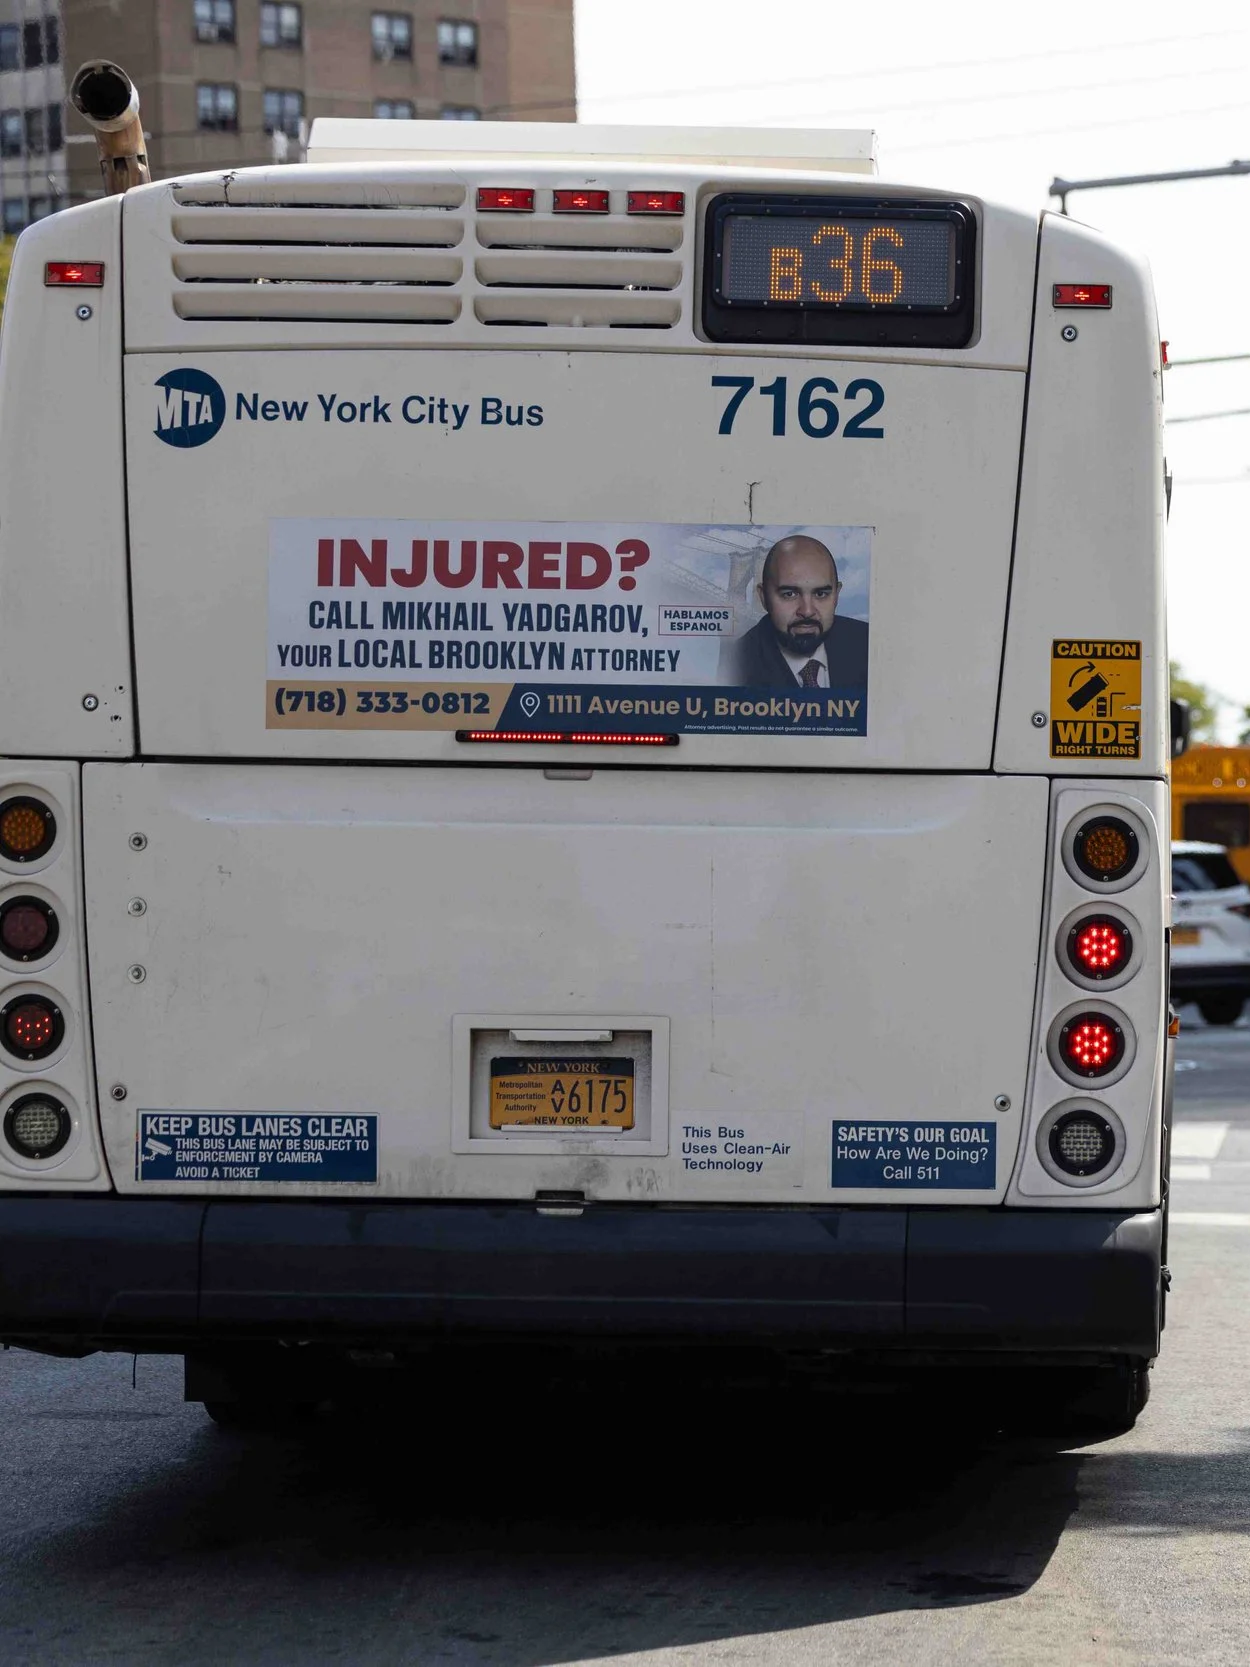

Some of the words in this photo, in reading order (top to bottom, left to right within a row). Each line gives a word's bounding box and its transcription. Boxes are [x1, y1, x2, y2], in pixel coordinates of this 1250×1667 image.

[770, 225, 904, 304] B36
[155, 385, 214, 432] MTA
[236, 393, 308, 422] New
[317, 394, 392, 424] York
[402, 395, 469, 430] City
[480, 397, 544, 426] Bus
[711, 375, 885, 438] 7162
[316, 538, 651, 592] INJURED?
[308, 600, 374, 630] CALL
[382, 601, 493, 631] MIKHAIL
[502, 602, 648, 638] YADGAROV,
[664, 610, 729, 621] HABLAMOS
[670, 622, 723, 632] ESPANOL
[277, 644, 332, 668] YOUR
[338, 638, 422, 668] LOCAL
[428, 640, 565, 670] BROOKLYN
[571, 648, 681, 672] ATTORNEY
[1057, 643, 1136, 656] CAUTION
[275, 688, 346, 715] (718)
[356, 692, 490, 714] 333-0812
[548, 694, 582, 714] 1111
[588, 696, 680, 716] Avenue
[685, 697, 708, 719] U,
[714, 698, 820, 722] Brooklyn
[826, 700, 860, 718] NY
[1056, 722, 1135, 744] WIDE
[1056, 746, 1092, 754] RIGHT
[1096, 746, 1135, 754] TURNS
[528, 1062, 560, 1073] NEW
[564, 1062, 600, 1073] YORK
[499, 1080, 543, 1090] Metropolitan
[496, 1092, 546, 1101] Transportation
[504, 1103, 537, 1112] Authority
[146, 1116, 192, 1136] KEEP
[198, 1117, 236, 1136] BUS
[242, 1118, 302, 1136] LANES
[308, 1118, 368, 1137] CLEAR
[534, 1116, 558, 1125] NEW
[560, 1116, 589, 1125] YORK
[683, 1126, 712, 1138] This
[718, 1126, 744, 1138] Bus
[838, 1126, 909, 1143] SAFETY'S
[914, 1127, 944, 1143] OUR
[950, 1127, 990, 1144] GOAL
[176, 1138, 202, 1150] THIS
[203, 1138, 225, 1150] BUS
[228, 1138, 258, 1150] LANE
[260, 1138, 284, 1150] MAY
[286, 1139, 300, 1150] BE
[303, 1139, 352, 1150] SUBJECT
[355, 1140, 368, 1150] TO
[682, 1142, 717, 1154] Uses
[724, 1142, 791, 1155] Clean-Air
[176, 1151, 256, 1162] ENFORCEMENT
[258, 1152, 274, 1162] BY
[276, 1152, 322, 1163] CAMERA
[836, 1146, 872, 1160] How
[875, 1146, 902, 1160] Are
[906, 1147, 930, 1160] We
[936, 1147, 988, 1164] Doing?
[176, 1166, 208, 1178] AVOID
[212, 1167, 220, 1178] A
[222, 1167, 260, 1178] TICKET
[682, 1158, 764, 1172] Technology
[883, 1166, 912, 1180] Call
[917, 1166, 940, 1180] 511
